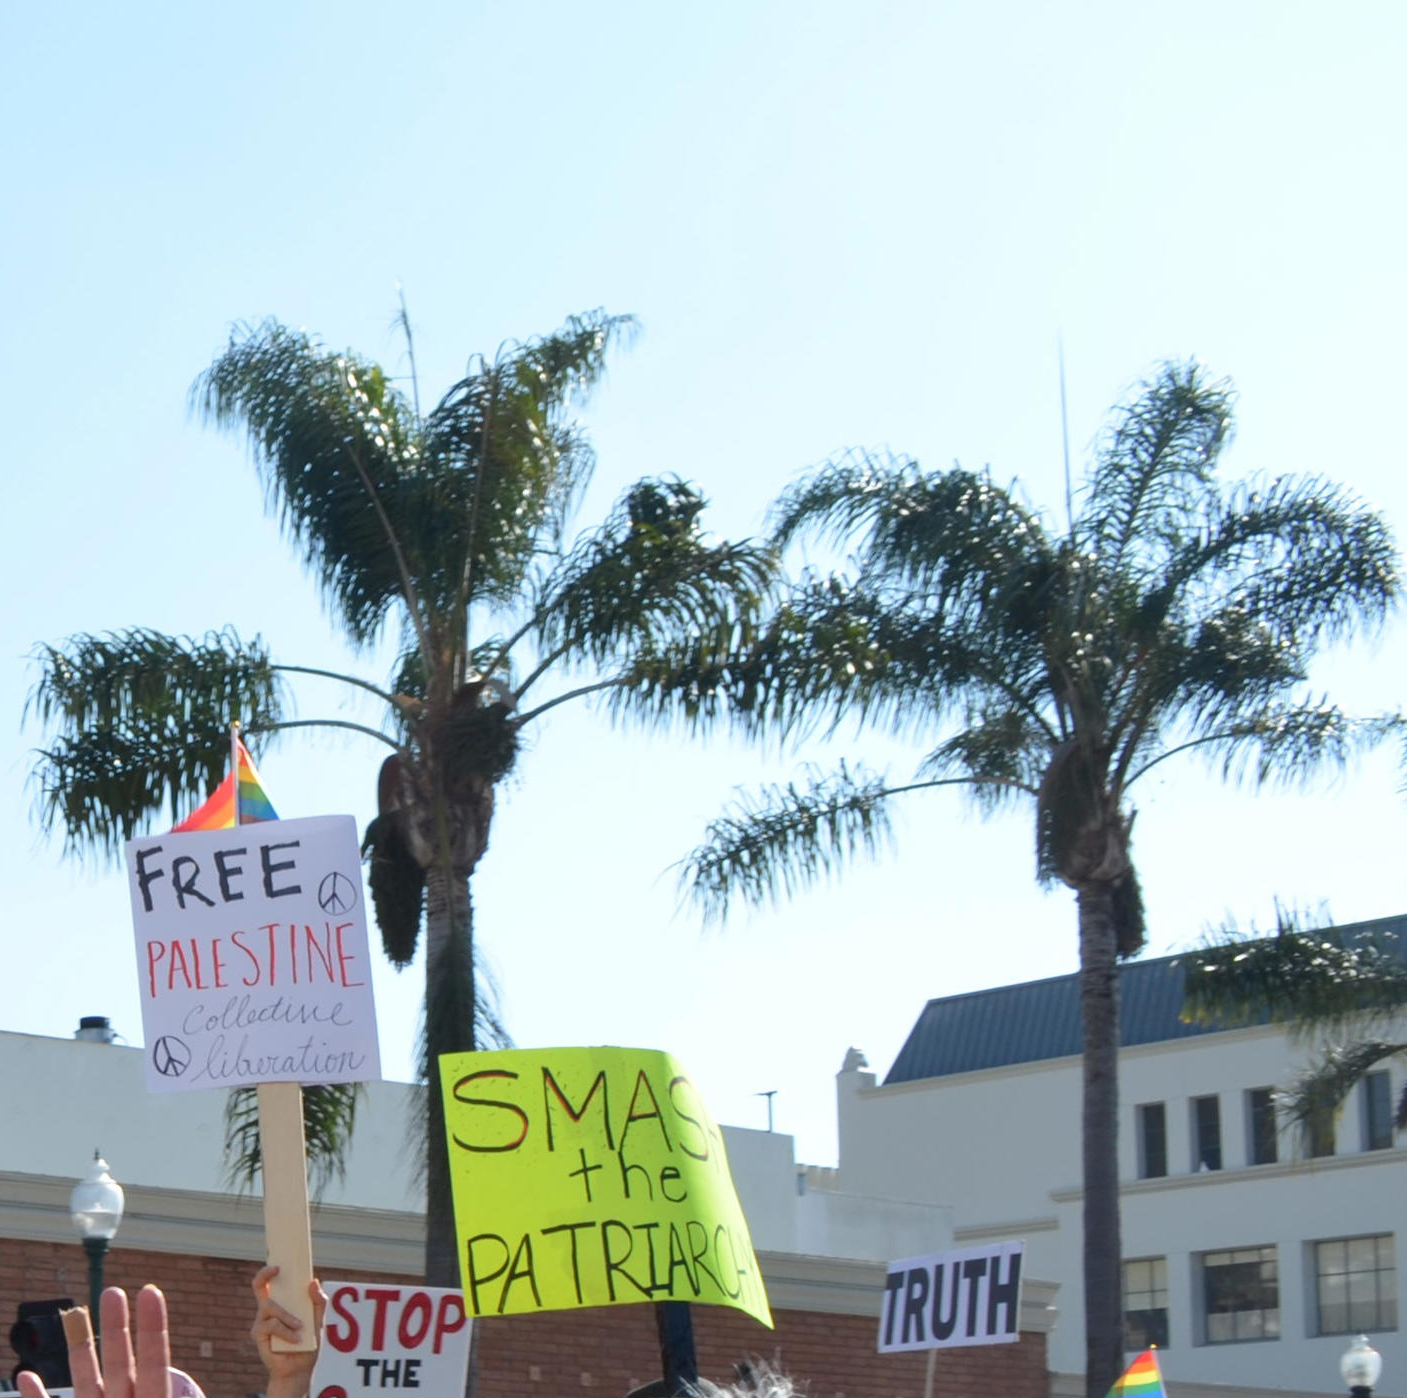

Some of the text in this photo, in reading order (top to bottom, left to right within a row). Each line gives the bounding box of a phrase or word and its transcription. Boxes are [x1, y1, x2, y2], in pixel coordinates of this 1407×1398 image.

[135, 840, 303, 912] FREE
[146, 922, 365, 998] PALESTINE
[191, 1034, 366, 1083] liberation
[568, 1148, 687, 1204] the
[326, 1286, 467, 1354] STOP
[885, 1253, 1021, 1346] TRUTH
[356, 1359, 421, 1388] THE
